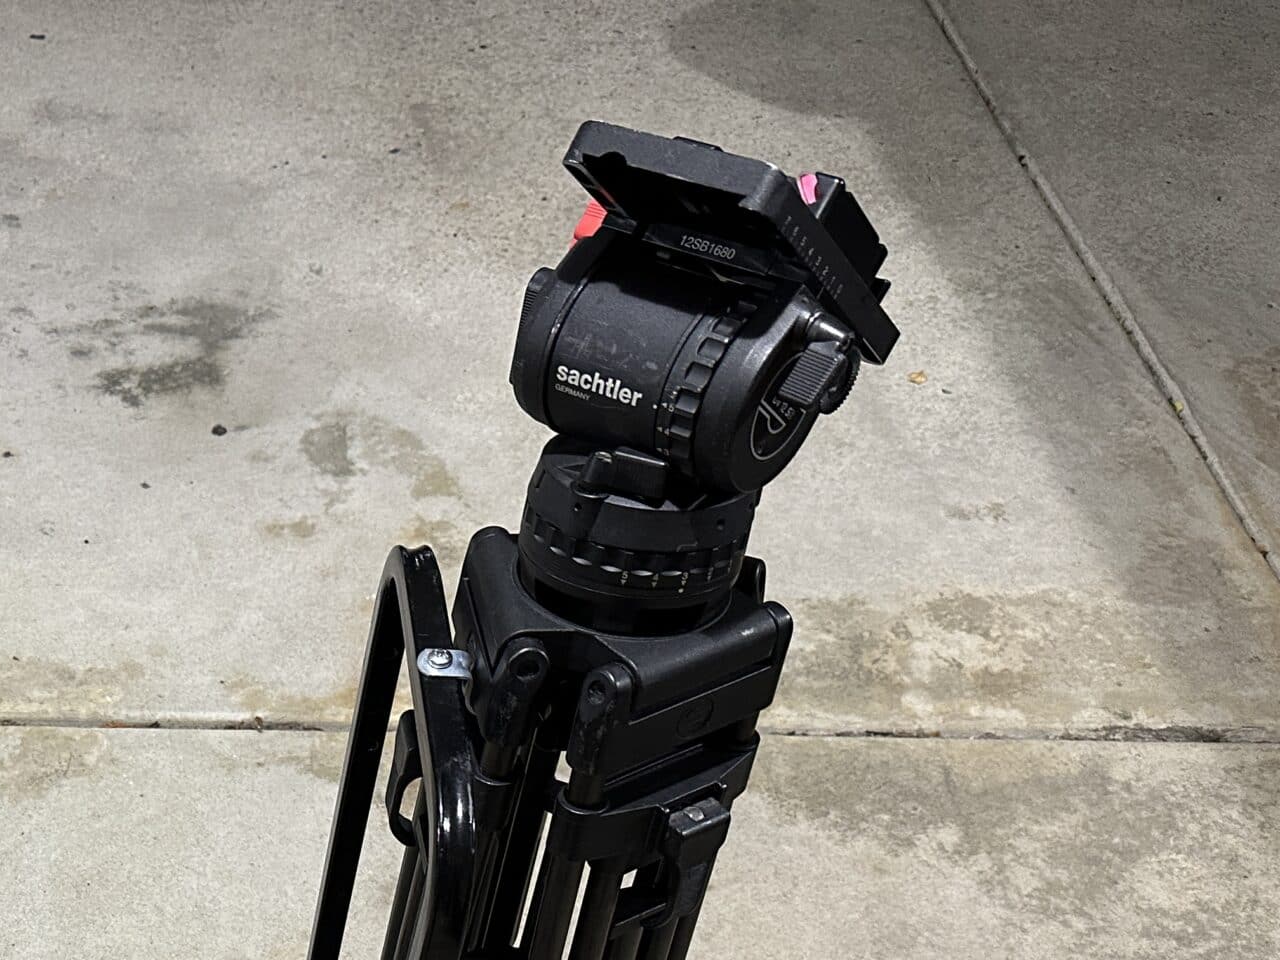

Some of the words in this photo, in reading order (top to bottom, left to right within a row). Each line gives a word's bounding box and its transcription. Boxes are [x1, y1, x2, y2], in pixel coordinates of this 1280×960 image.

[680, 235, 736, 260] 12SB1680
[555, 383, 591, 401] GERMANY
[556, 365, 643, 407] sachtler
